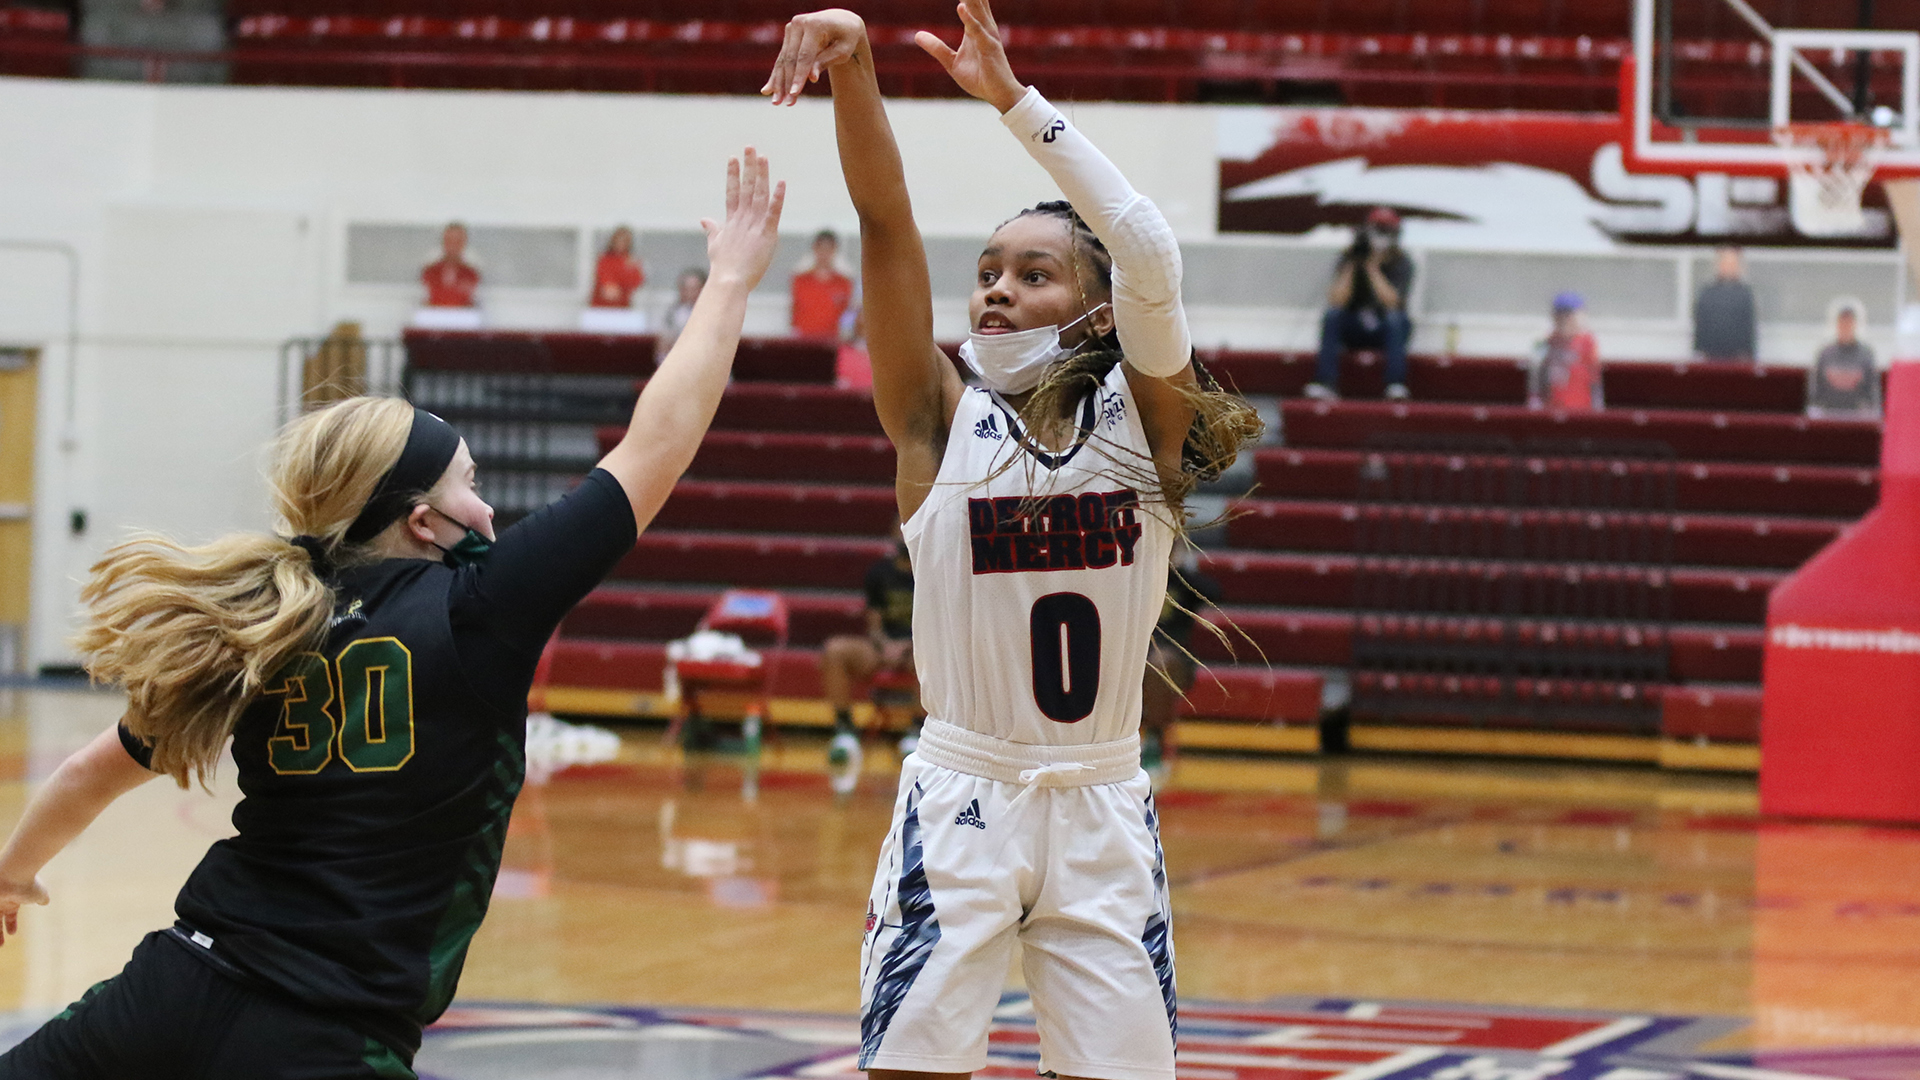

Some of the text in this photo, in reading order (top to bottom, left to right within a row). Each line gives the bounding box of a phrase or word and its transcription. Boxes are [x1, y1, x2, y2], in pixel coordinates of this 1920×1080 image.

[968, 489, 1140, 535] DETROIT
[972, 523, 1142, 575] MERCY
[1030, 591, 1101, 723] 0
[263, 636, 415, 774] 30
